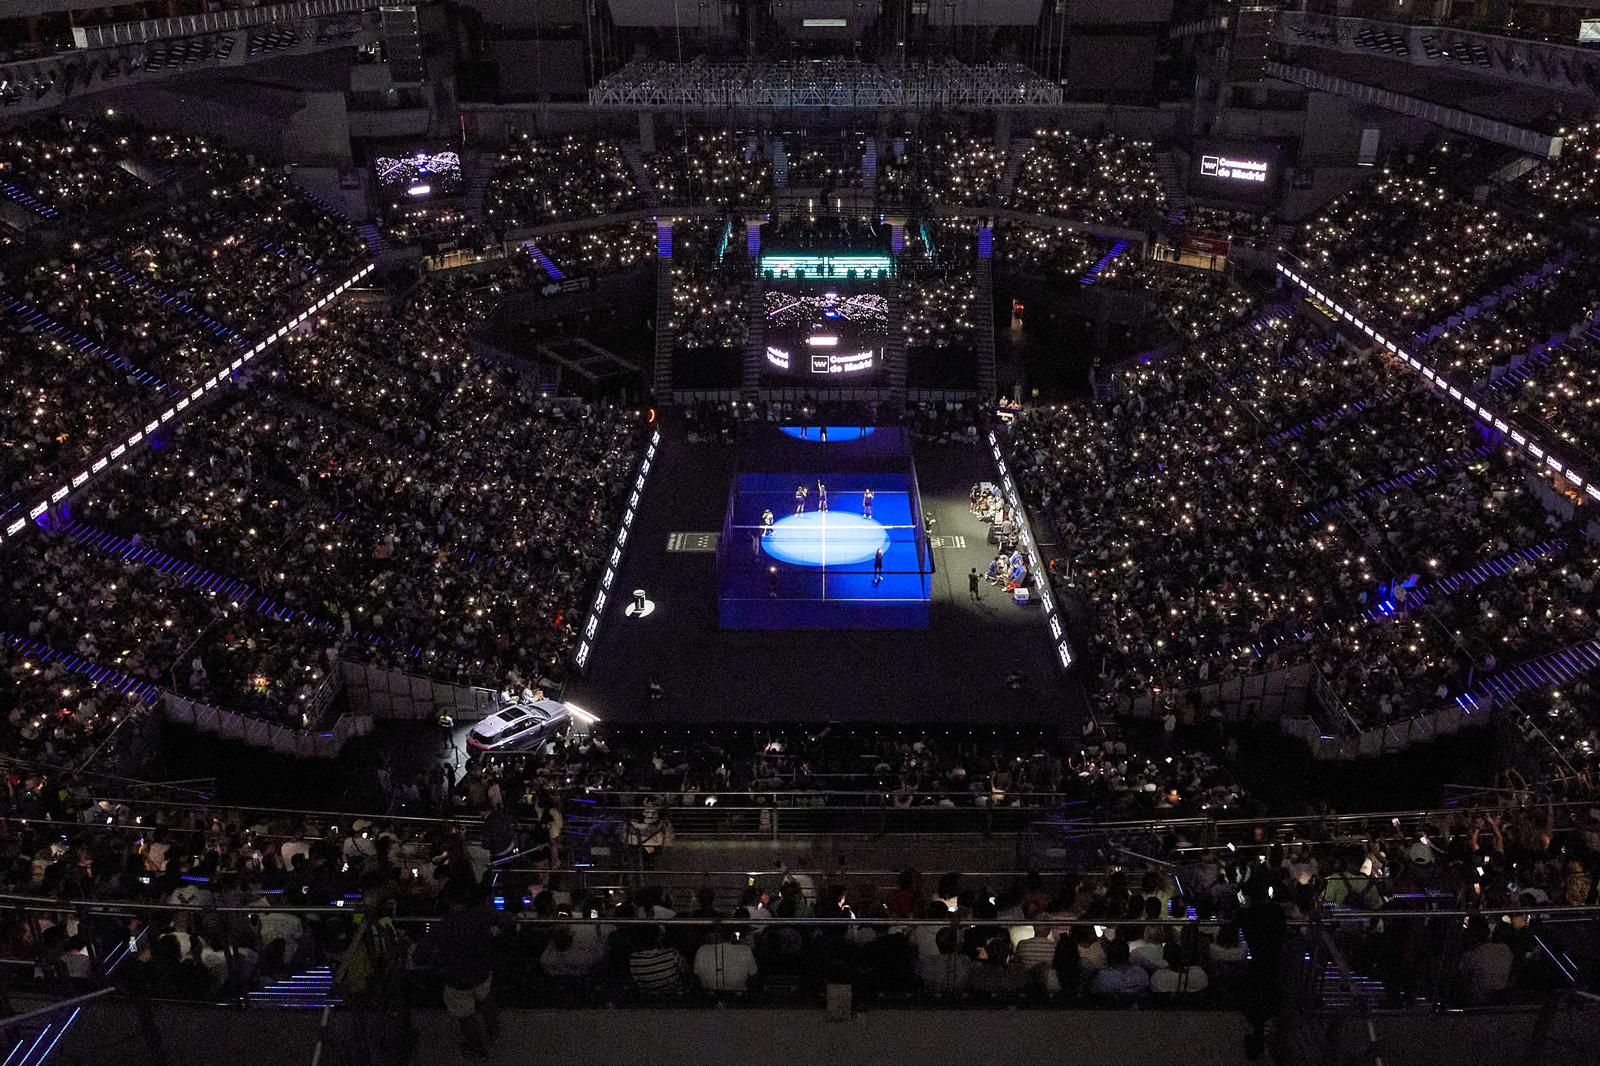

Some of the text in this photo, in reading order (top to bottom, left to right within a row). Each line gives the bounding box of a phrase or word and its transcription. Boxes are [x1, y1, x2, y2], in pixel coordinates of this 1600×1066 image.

[1219, 158, 1266, 171] Comunidad
[1218, 168, 1265, 181] de Madrid
[830, 350, 872, 363] Comunidad
[830, 358, 872, 372] de Madrid
